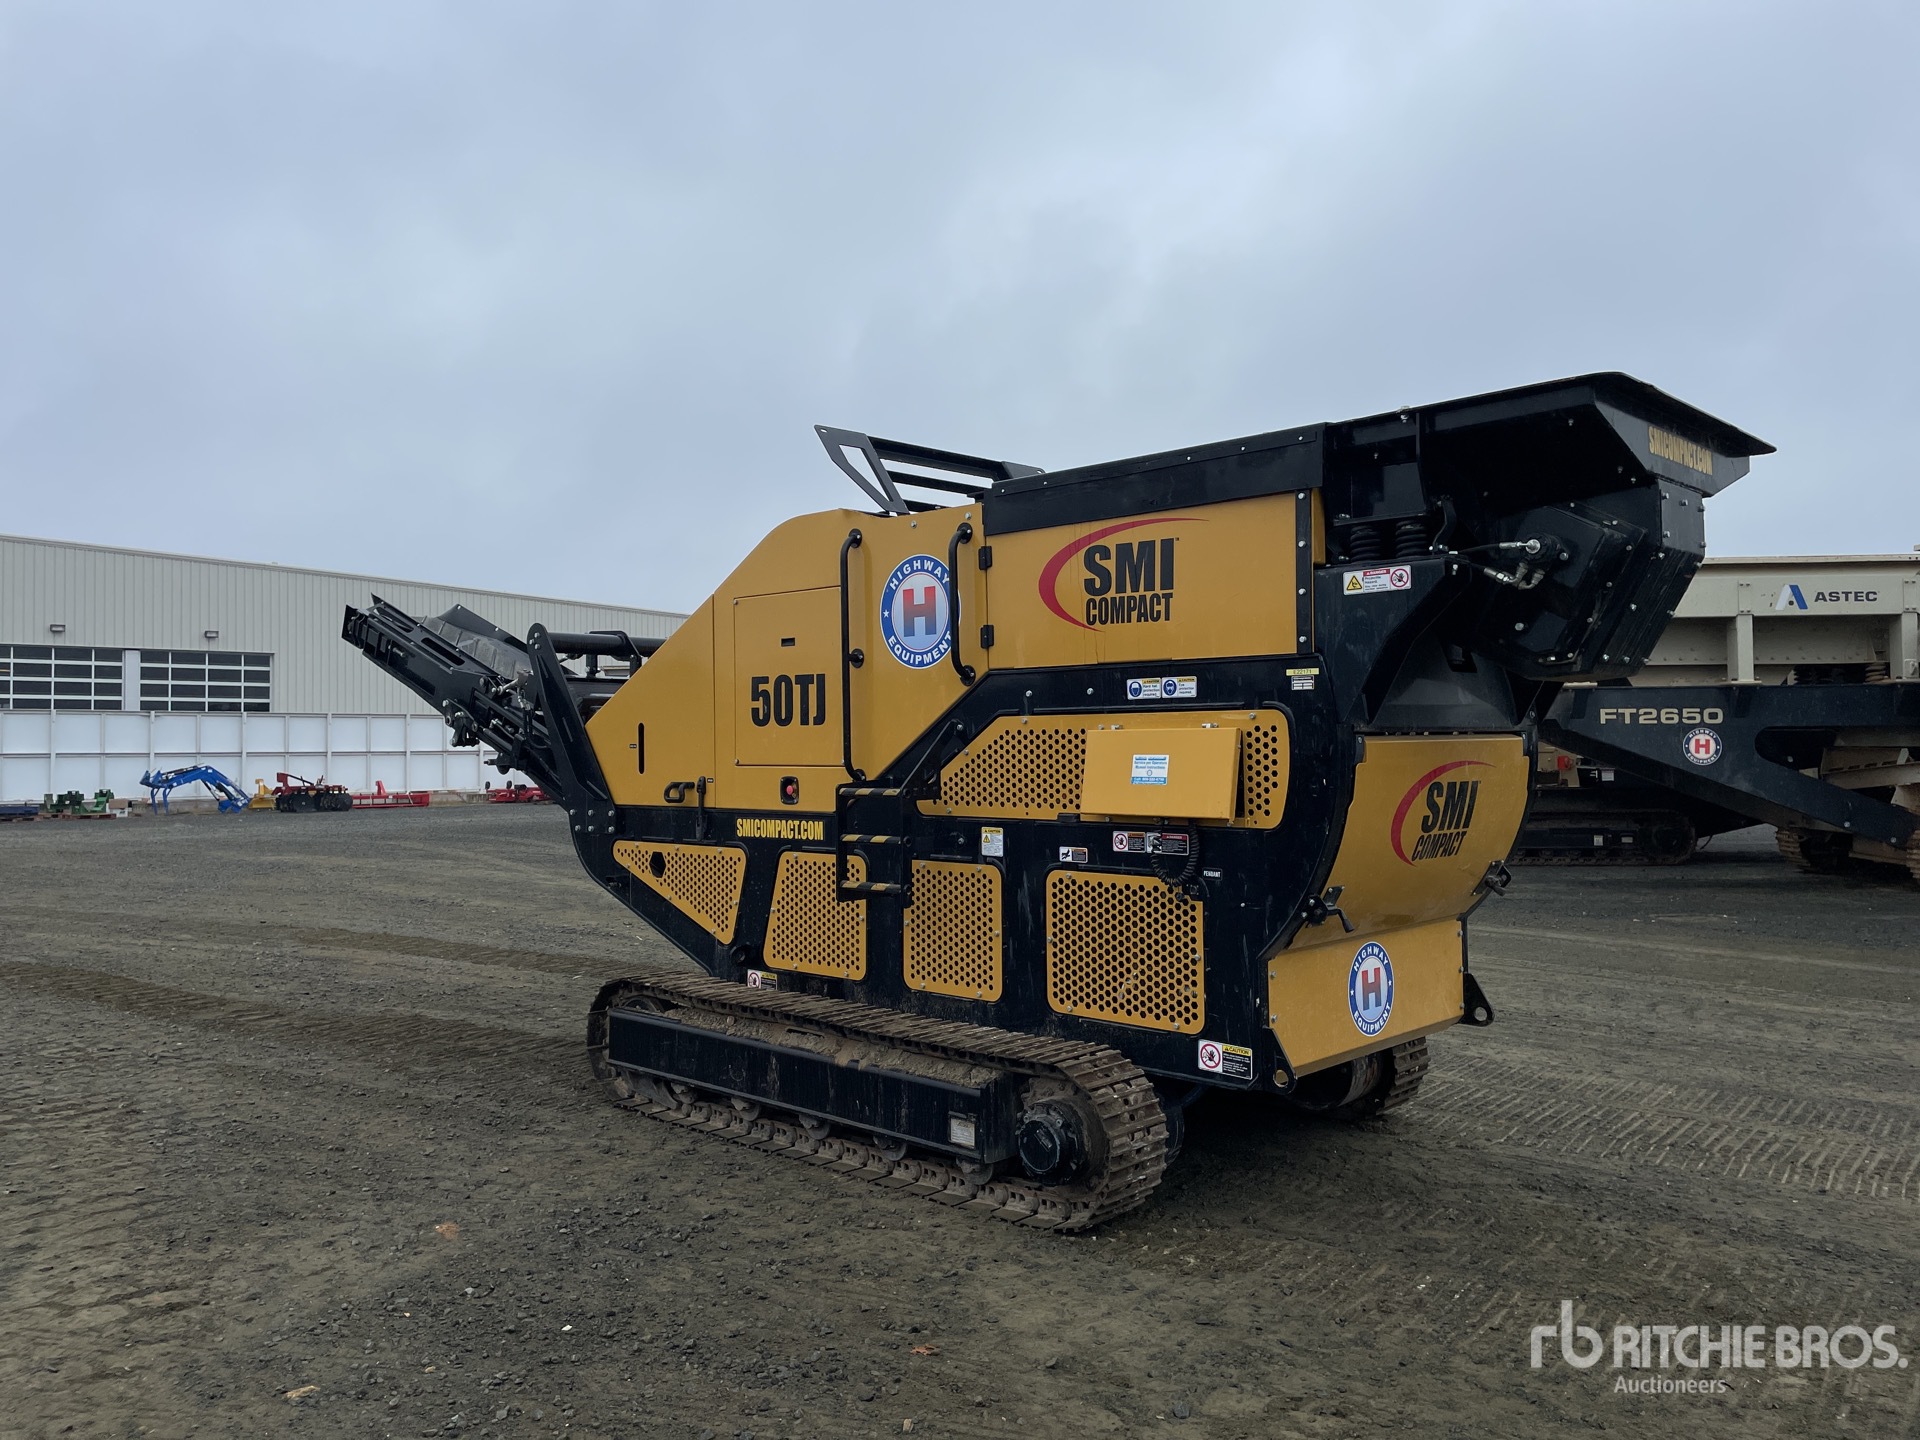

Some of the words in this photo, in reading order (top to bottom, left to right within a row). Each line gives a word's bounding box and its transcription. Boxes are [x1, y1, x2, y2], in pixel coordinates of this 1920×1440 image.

[889, 559, 950, 591] HIGHWAY
[1083, 538, 1175, 597] SMI
[902, 585, 937, 637] H
[1085, 592, 1174, 626] COMPACT
[1814, 591, 1878, 602] ASTEC
[888, 630, 952, 665] EQUIPMENT
[751, 673, 826, 728] 50TJ
[1599, 708, 1724, 725] FT2650
[1689, 729, 1716, 738] HIGHWAY
[1694, 738, 1711, 755] H
[1687, 752, 1717, 763] EQUIPMENT
[1421, 780, 1480, 834] SMI
[736, 818, 824, 841] SMICOMPACT.COM
[1411, 830, 1468, 862] COMPACT
[1203, 870, 1221, 878] PENDANT
[1353, 945, 1389, 972] HIGHWAY
[1361, 966, 1383, 1012] H
[1353, 1001, 1391, 1033] EQUIPMENT
[1229, 1046, 1250, 1055] CAUTION
